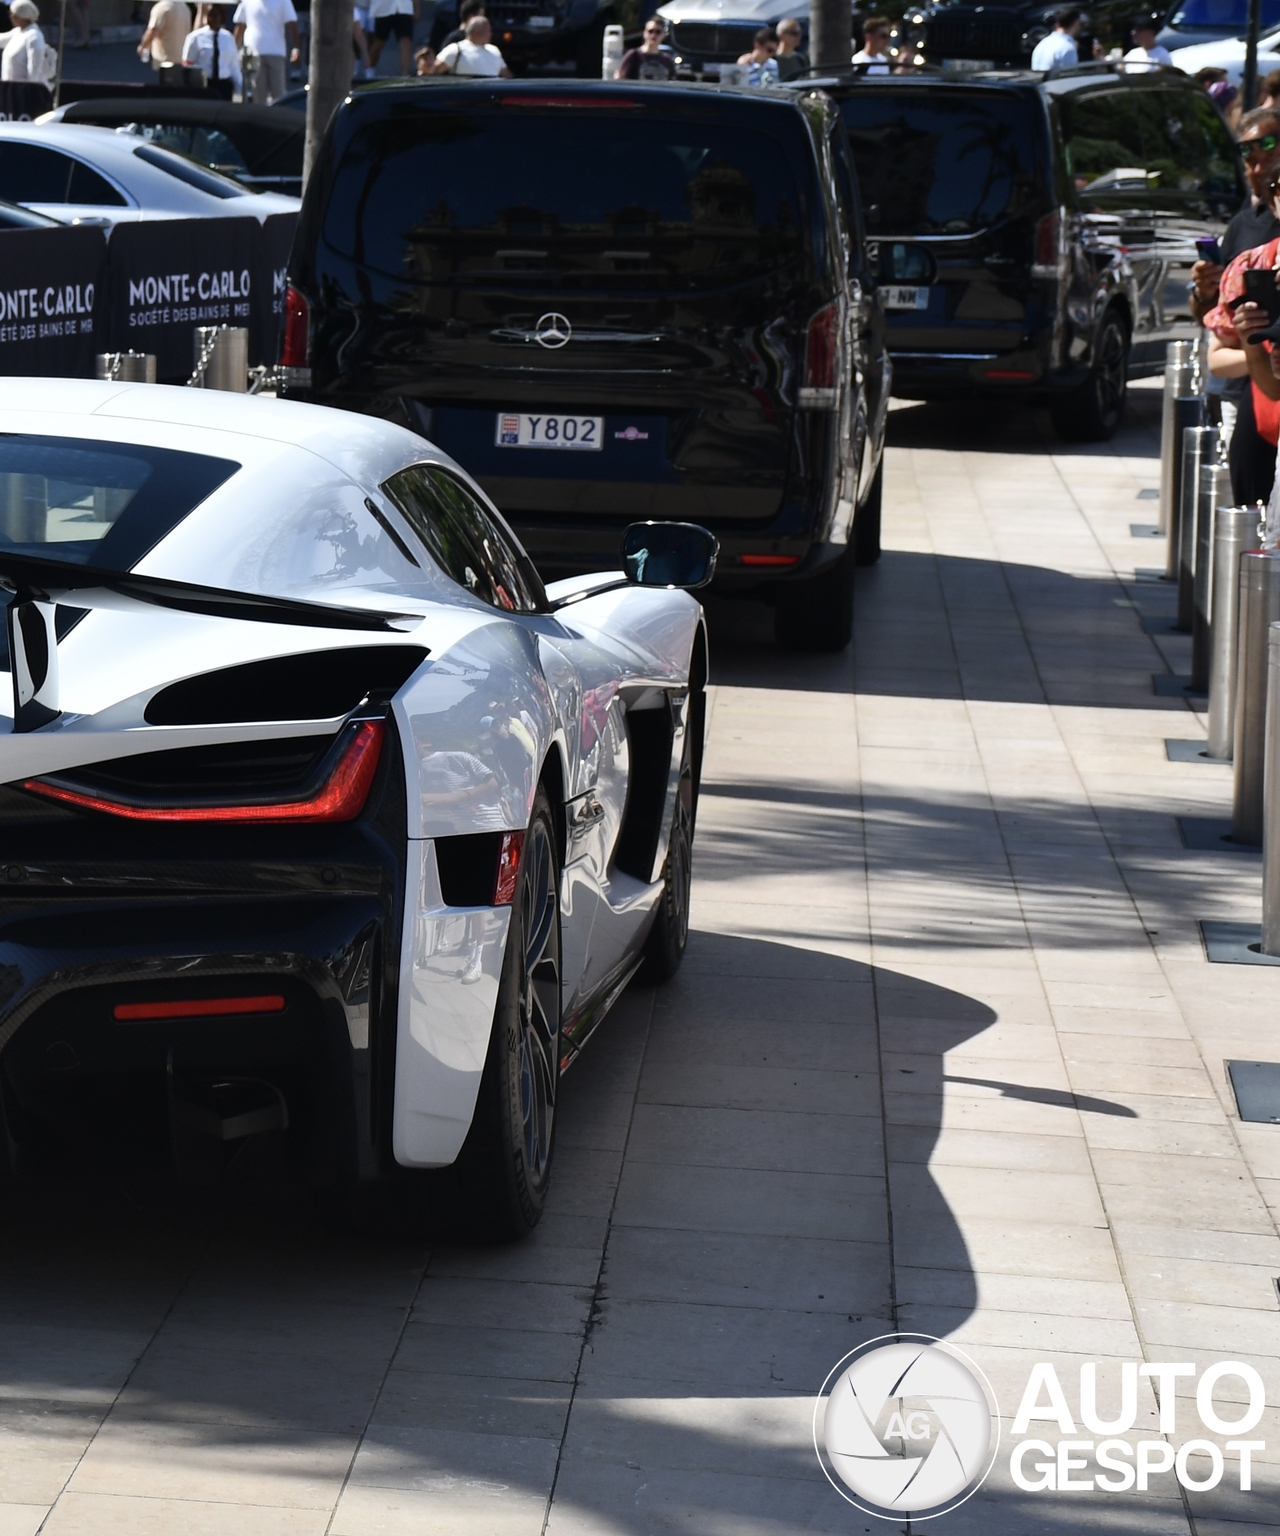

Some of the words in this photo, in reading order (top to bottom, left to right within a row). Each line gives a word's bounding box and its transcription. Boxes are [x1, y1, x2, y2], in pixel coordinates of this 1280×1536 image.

[173, 308, 188, 323] DES
[20, 324, 36, 340] DES
[527, 416, 597, 443] Y802
